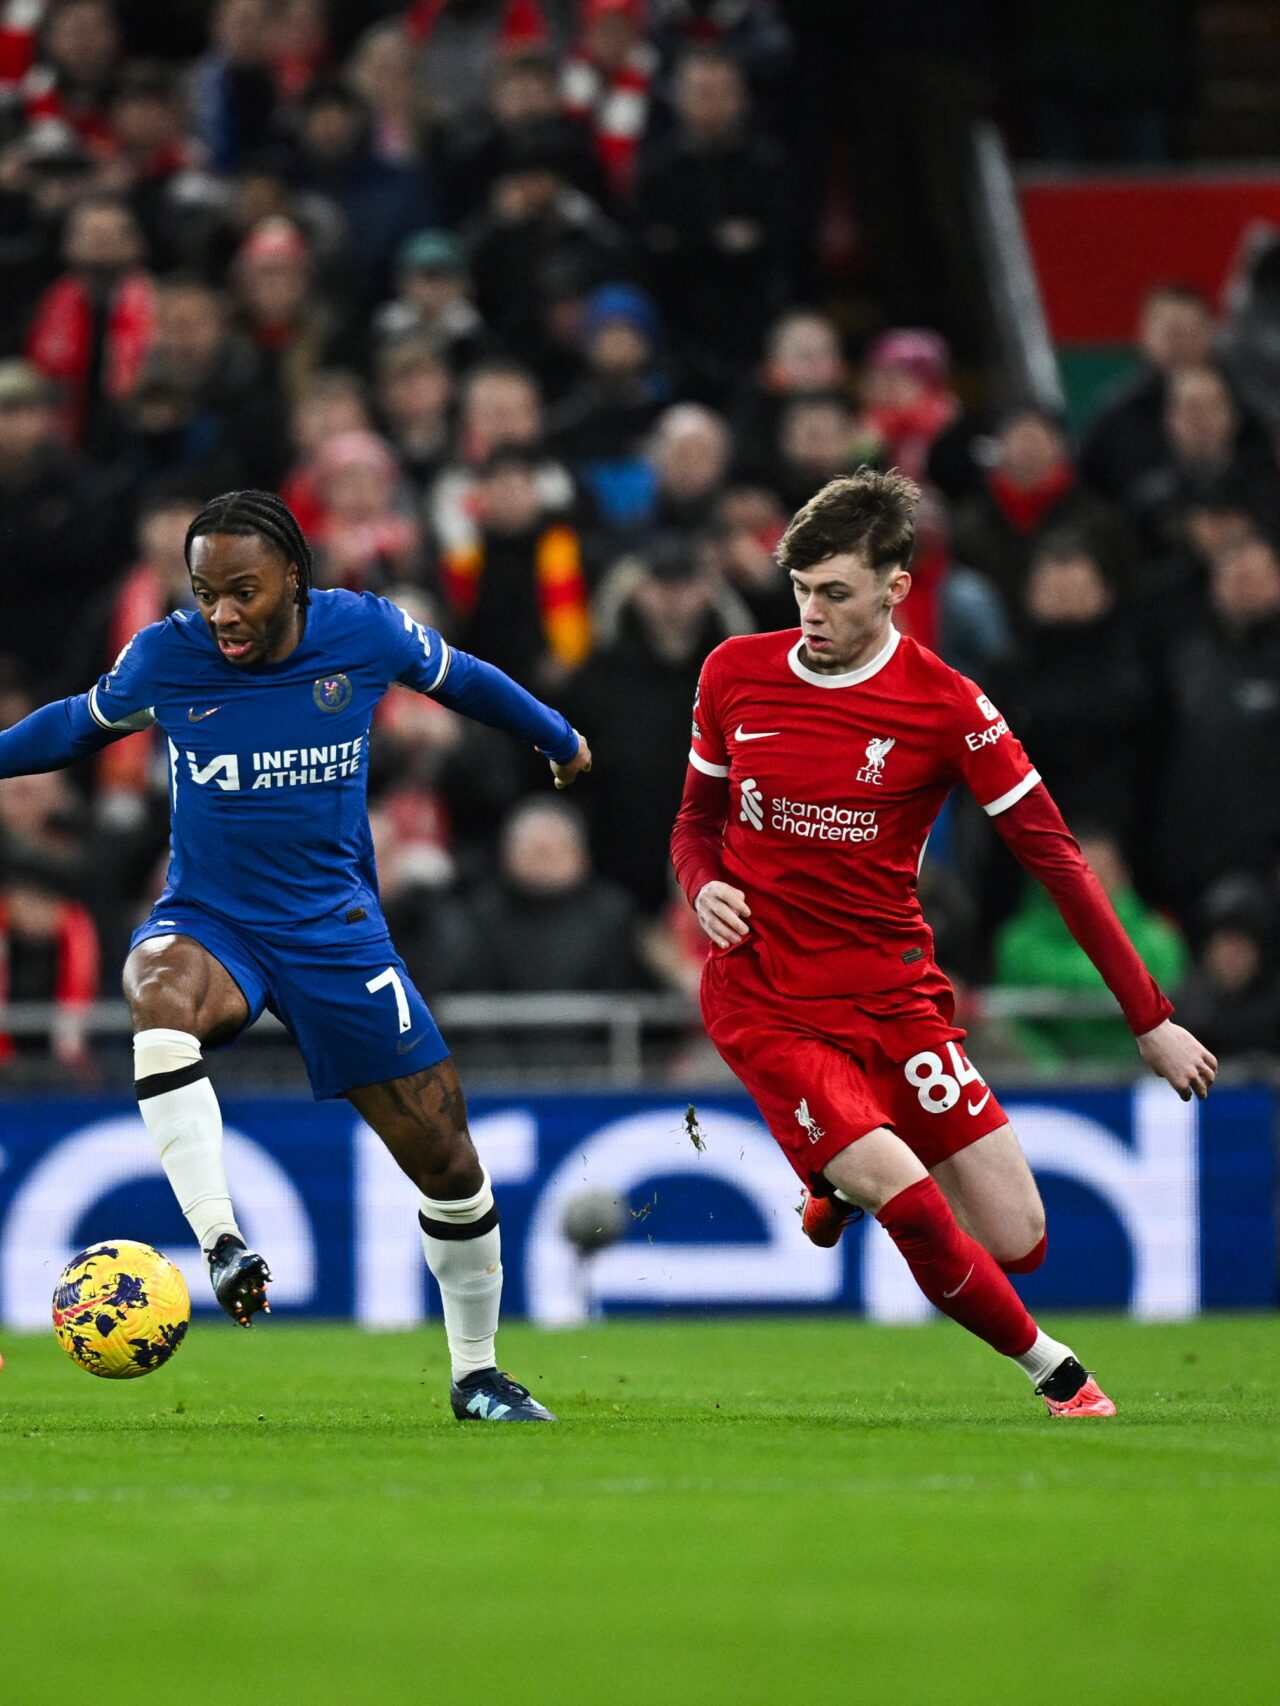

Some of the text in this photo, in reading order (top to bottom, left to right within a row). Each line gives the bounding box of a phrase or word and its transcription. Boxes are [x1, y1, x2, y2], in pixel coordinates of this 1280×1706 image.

[252, 736, 364, 771] INFINITE
[251, 755, 360, 790] ATHLETE
[771, 813, 879, 843] chartered
[772, 796, 877, 825] standard
[365, 966, 412, 1034] 7
[904, 1041, 987, 1114] 84
